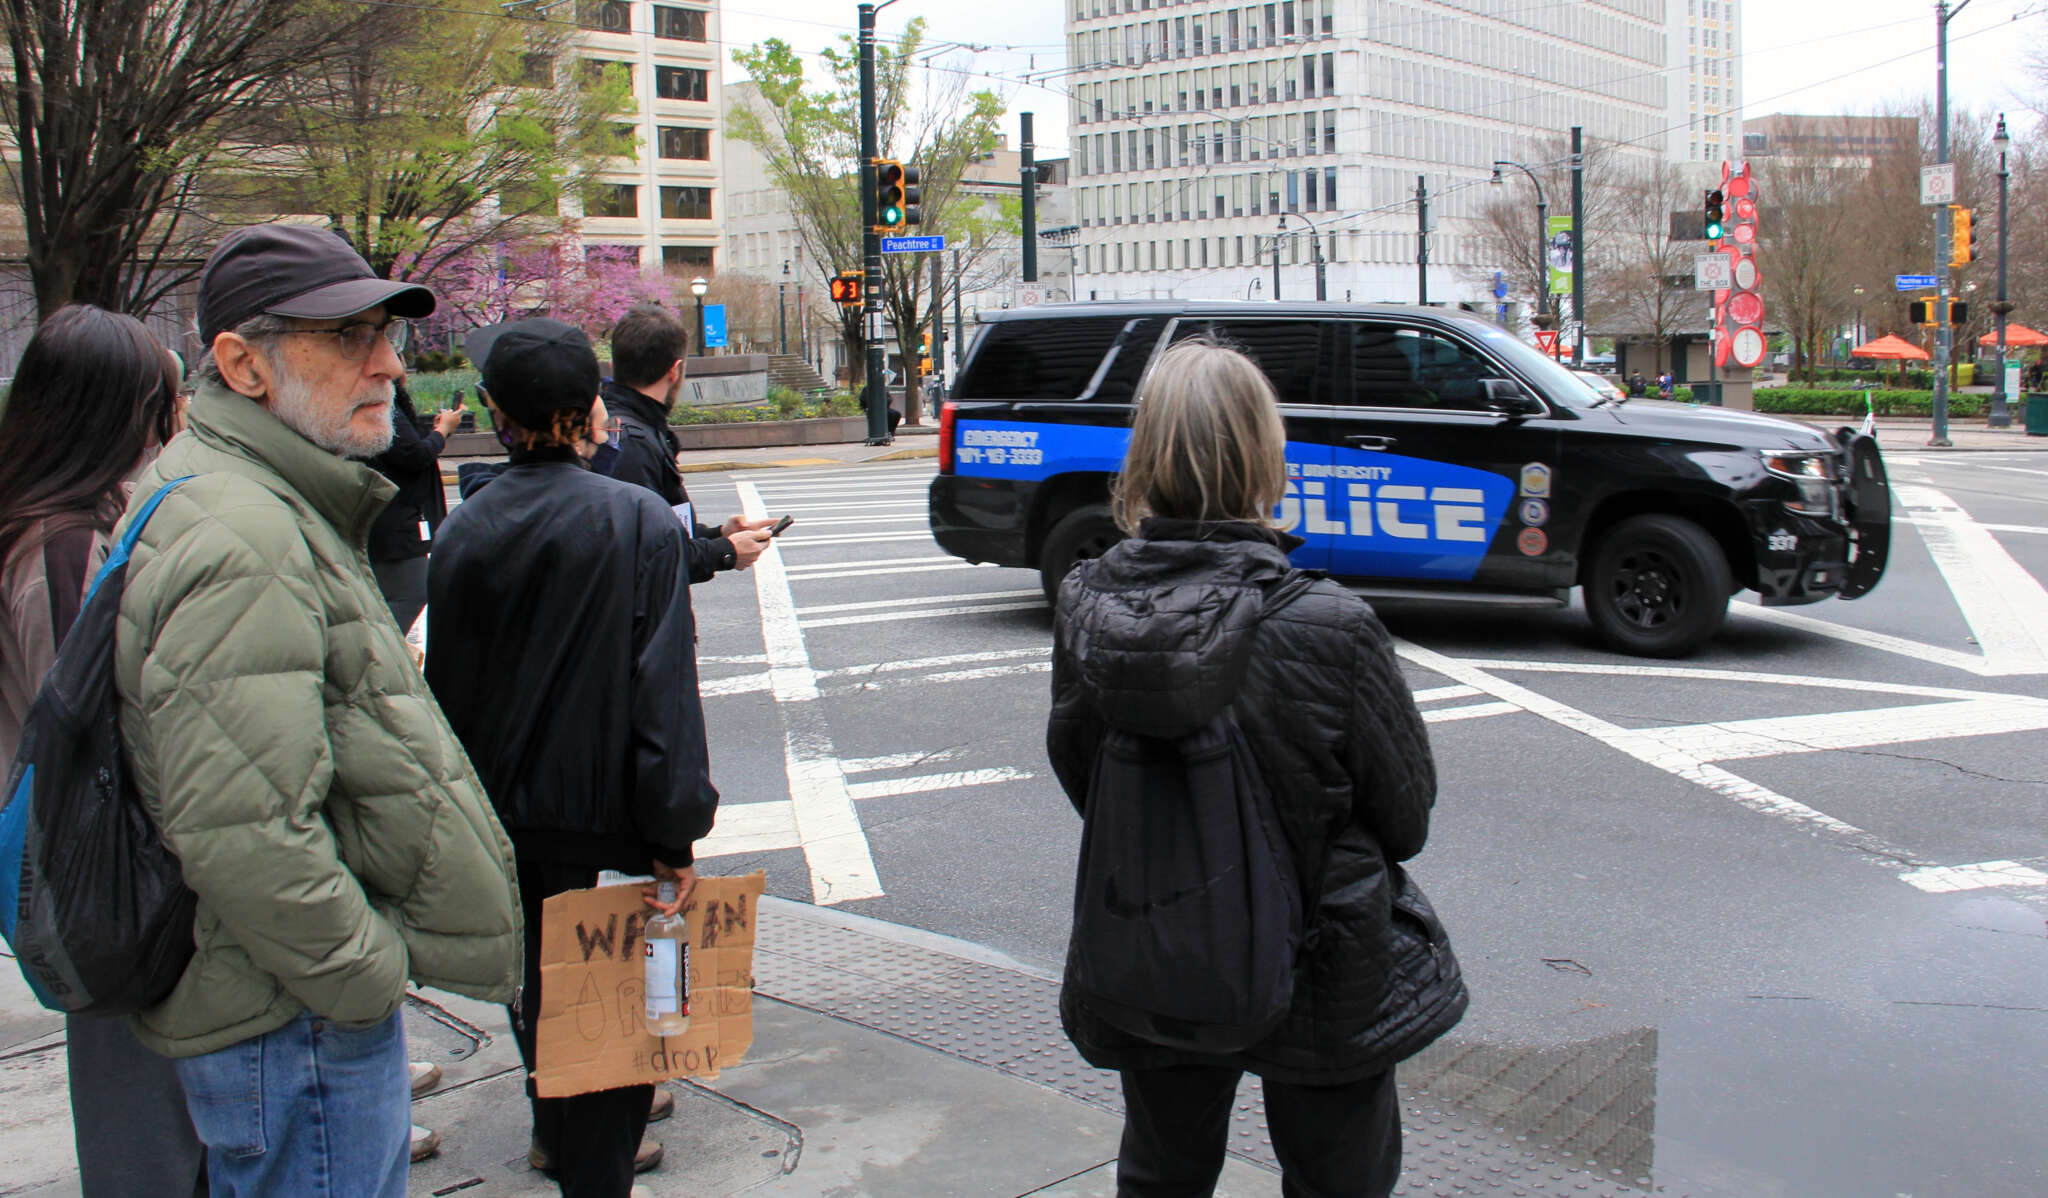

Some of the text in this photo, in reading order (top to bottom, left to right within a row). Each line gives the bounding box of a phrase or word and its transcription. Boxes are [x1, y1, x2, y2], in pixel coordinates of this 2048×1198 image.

[886, 239, 929, 250] Peachtree
[848, 281, 858, 299] 3
[1302, 463, 1393, 481] UNIVERSITY
[1268, 480, 1487, 543] OLICE
[632, 1036, 718, 1074] #drop
